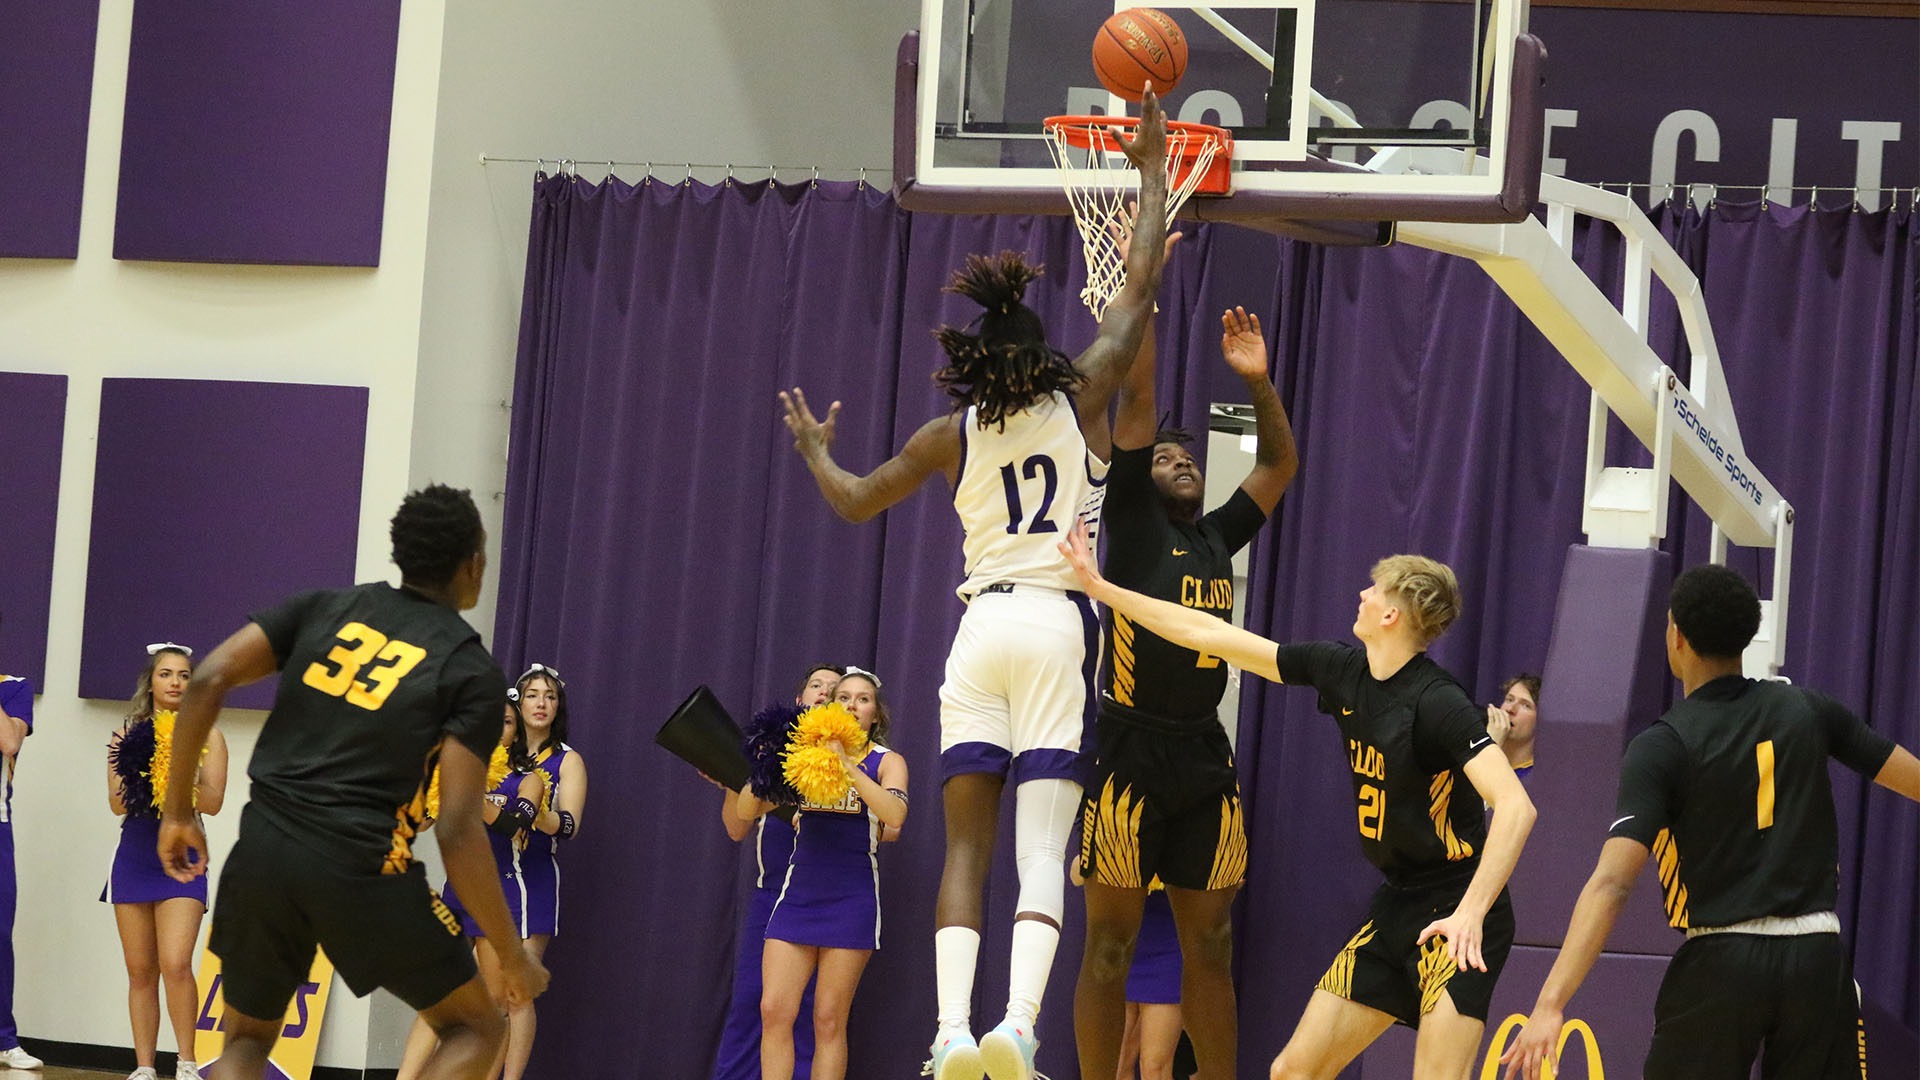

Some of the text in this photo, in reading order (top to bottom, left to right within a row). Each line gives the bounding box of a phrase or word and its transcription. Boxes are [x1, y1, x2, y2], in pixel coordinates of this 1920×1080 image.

[1119, 17, 1165, 65] SPALDIN
[1000, 454, 1058, 535] 12
[1677, 399, 1763, 506] Schelde Sports
[302, 621, 428, 712] 33
[1358, 783, 1386, 842] 21
[1756, 739, 1776, 830] 1
